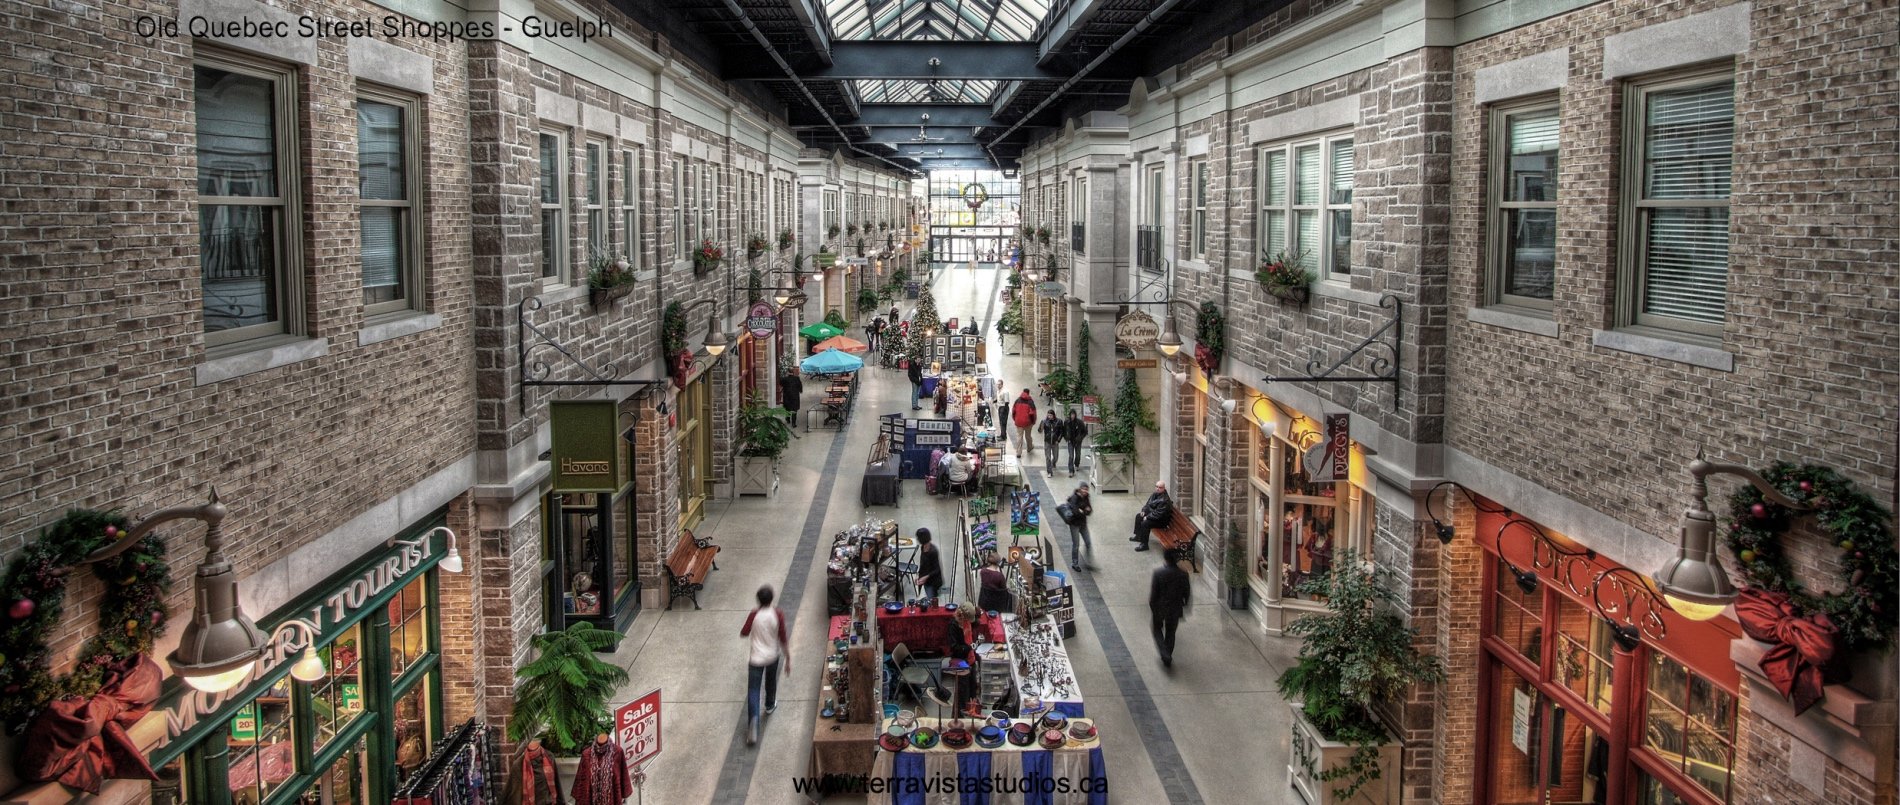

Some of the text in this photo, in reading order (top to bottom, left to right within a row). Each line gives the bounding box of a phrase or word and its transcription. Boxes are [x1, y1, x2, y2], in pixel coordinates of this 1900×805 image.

[1119, 323, 1157, 337] La Crème
[561, 457, 609, 472] Havana
[328, 531, 435, 623] TOURIST
[623, 702, 654, 725] Sale
[624, 716, 654, 743] 20%
[624, 734, 654, 761] 50%
